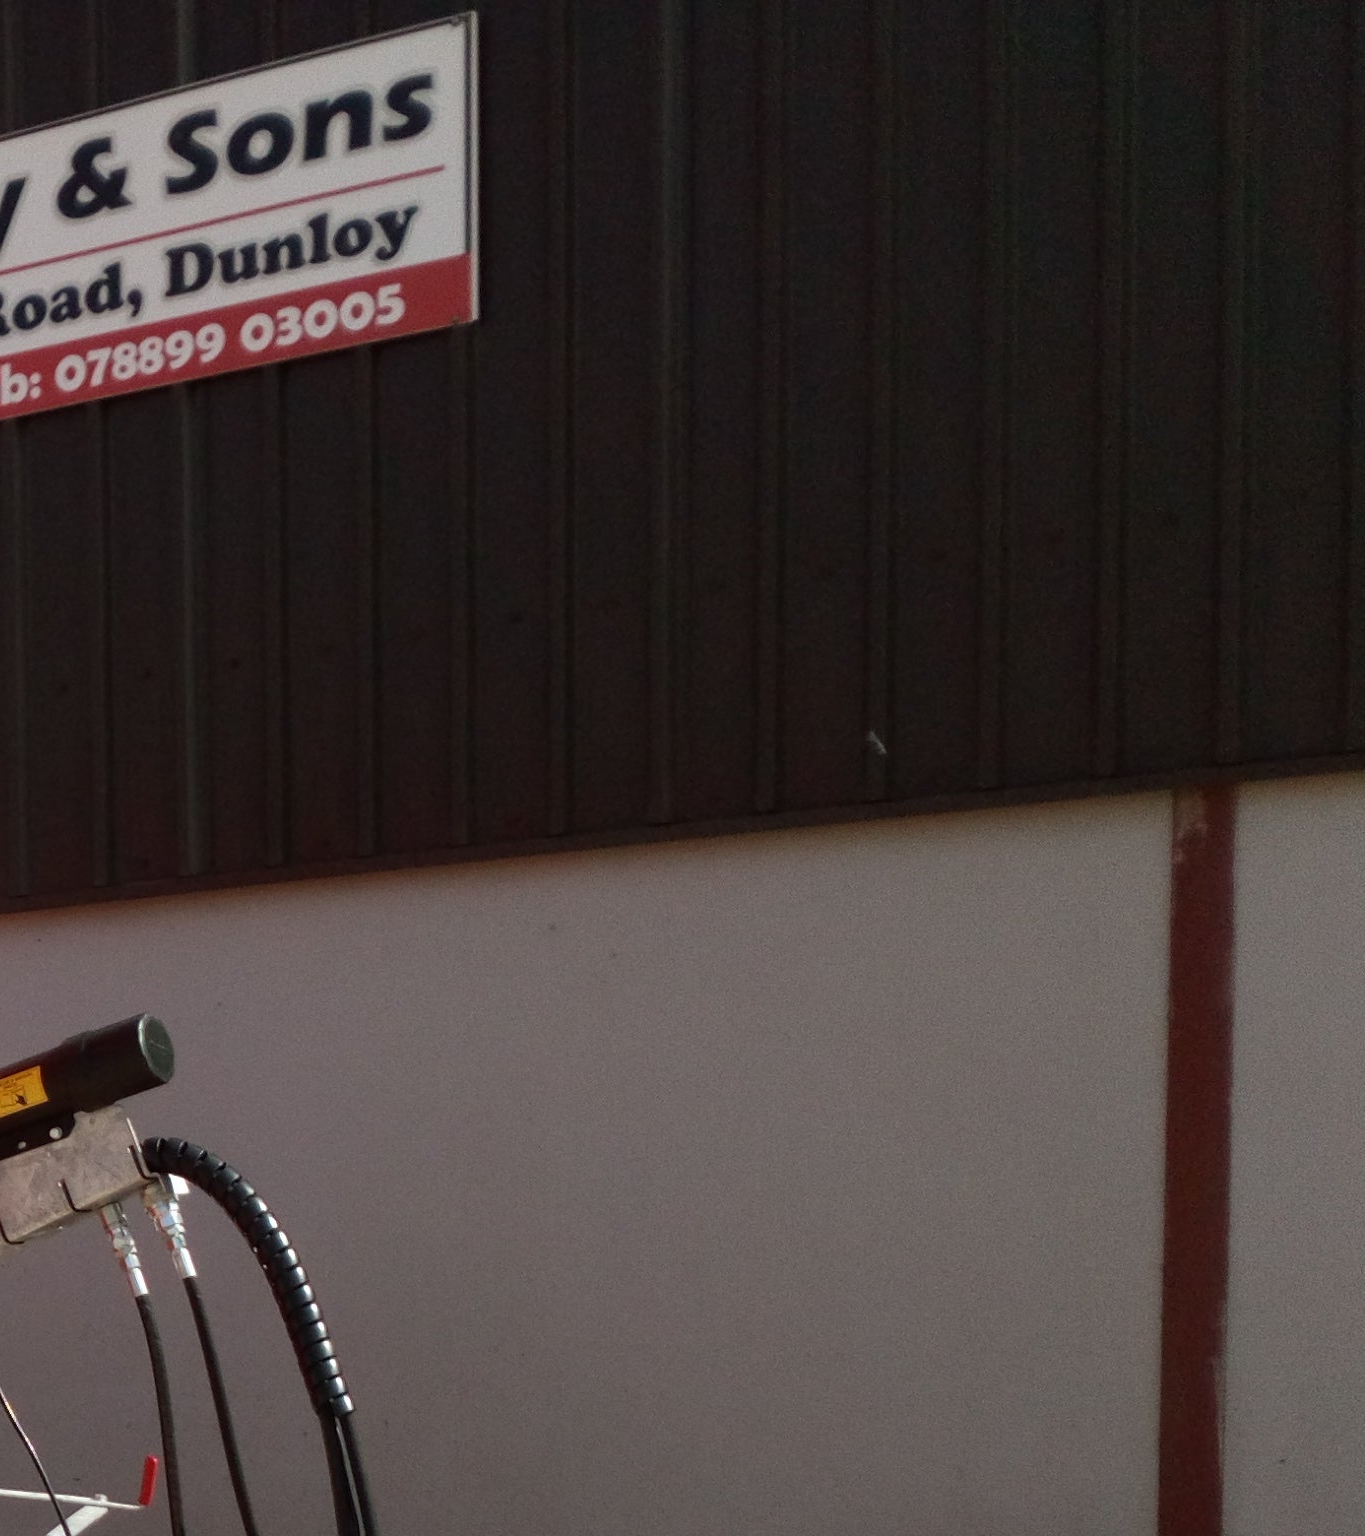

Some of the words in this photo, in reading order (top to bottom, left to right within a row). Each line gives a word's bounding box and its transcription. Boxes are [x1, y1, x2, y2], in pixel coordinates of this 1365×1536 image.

[57, 137, 132, 219] &
[165, 74, 433, 196] Sons
[165, 205, 419, 297] Dunloy
[54, 323, 226, 392] 078899
[239, 284, 407, 353] 03005
